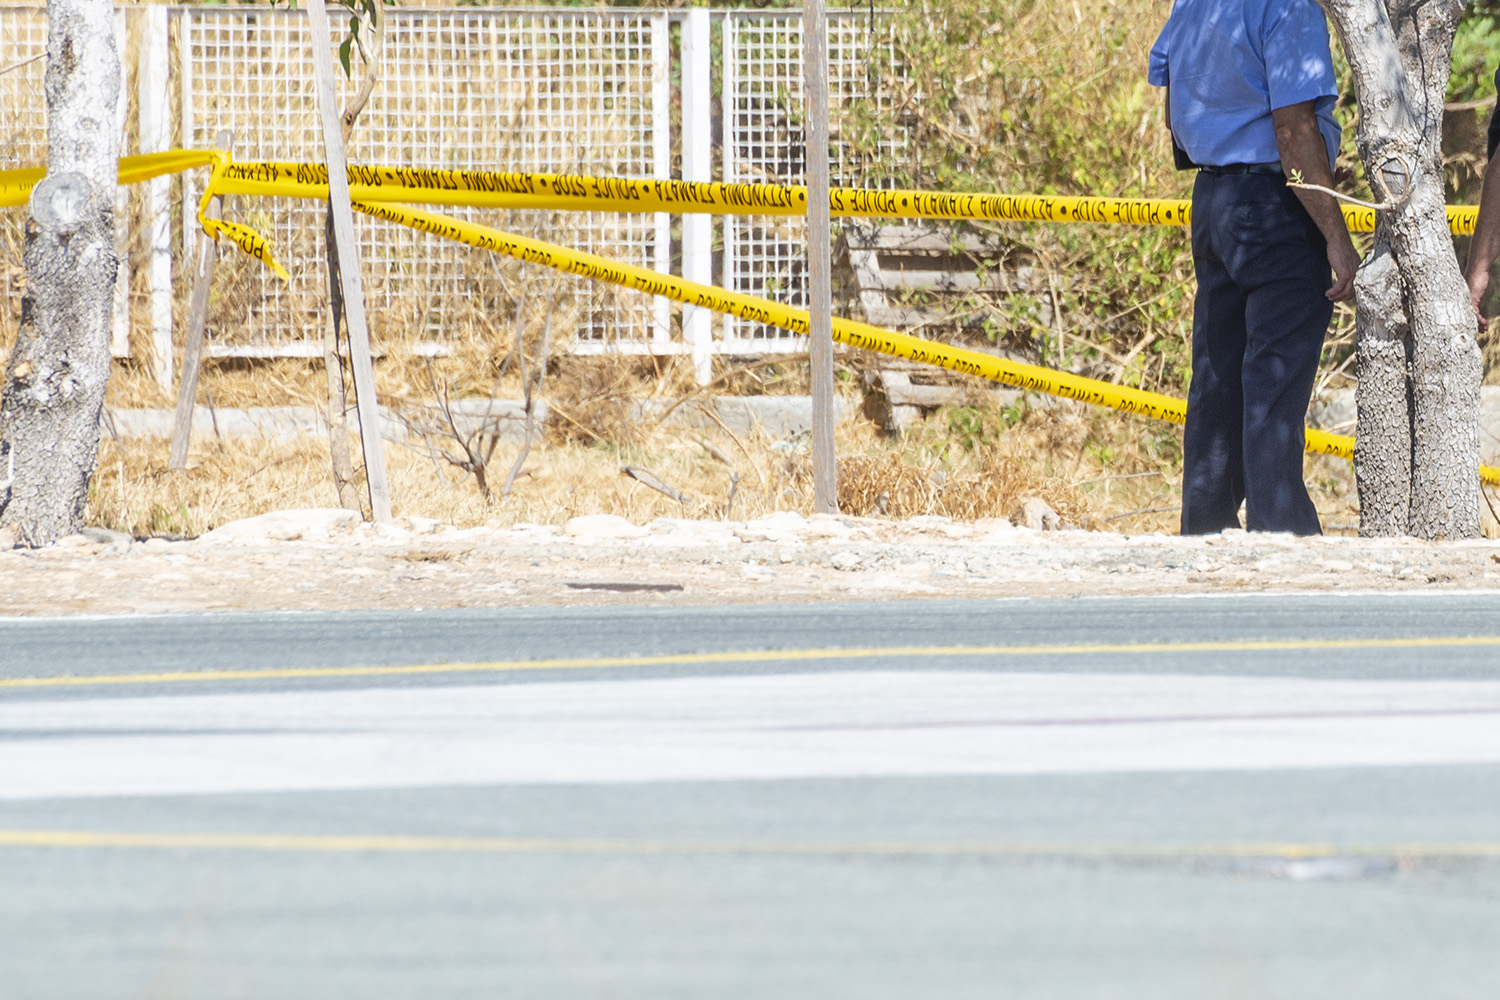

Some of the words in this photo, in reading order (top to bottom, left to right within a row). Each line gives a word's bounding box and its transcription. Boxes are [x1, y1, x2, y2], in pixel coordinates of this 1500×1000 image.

[345, 166, 382, 186] POLIC
[552, 175, 586, 197] STOP
[592, 177, 638, 200] POLICE
[850, 190, 898, 213] POLICE
[1072, 200, 1108, 223] STOP
[1113, 202, 1161, 225] POLICE
